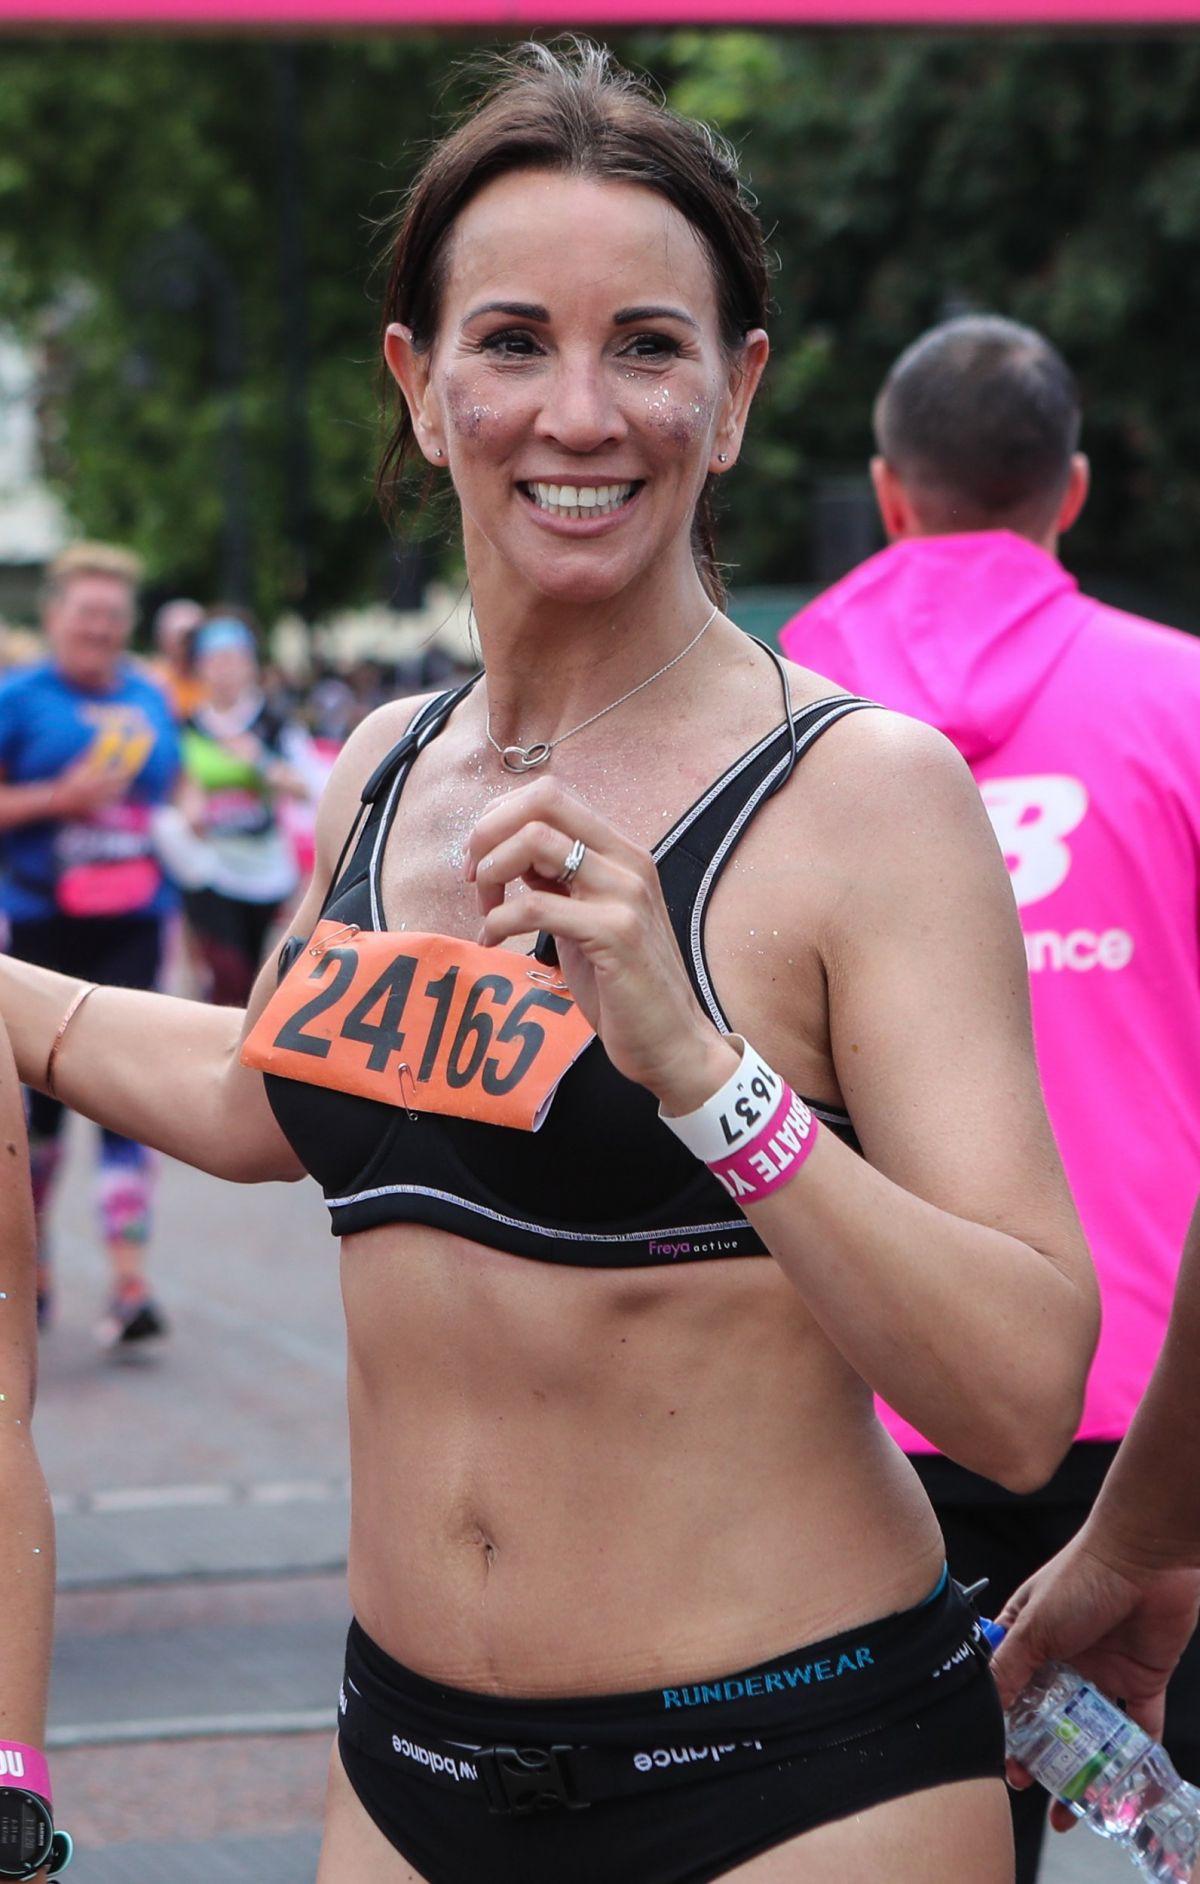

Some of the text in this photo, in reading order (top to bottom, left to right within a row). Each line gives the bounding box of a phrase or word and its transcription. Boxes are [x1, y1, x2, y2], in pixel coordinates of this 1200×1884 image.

[273, 948, 575, 1096] 24165
[719, 1065, 777, 1146] 1637
[747, 1088, 812, 1183] BRATE
[648, 1240, 738, 1259] Freya active
[662, 1646, 876, 1709] RUNDERWEAR
[391, 1734, 459, 1781] balance
